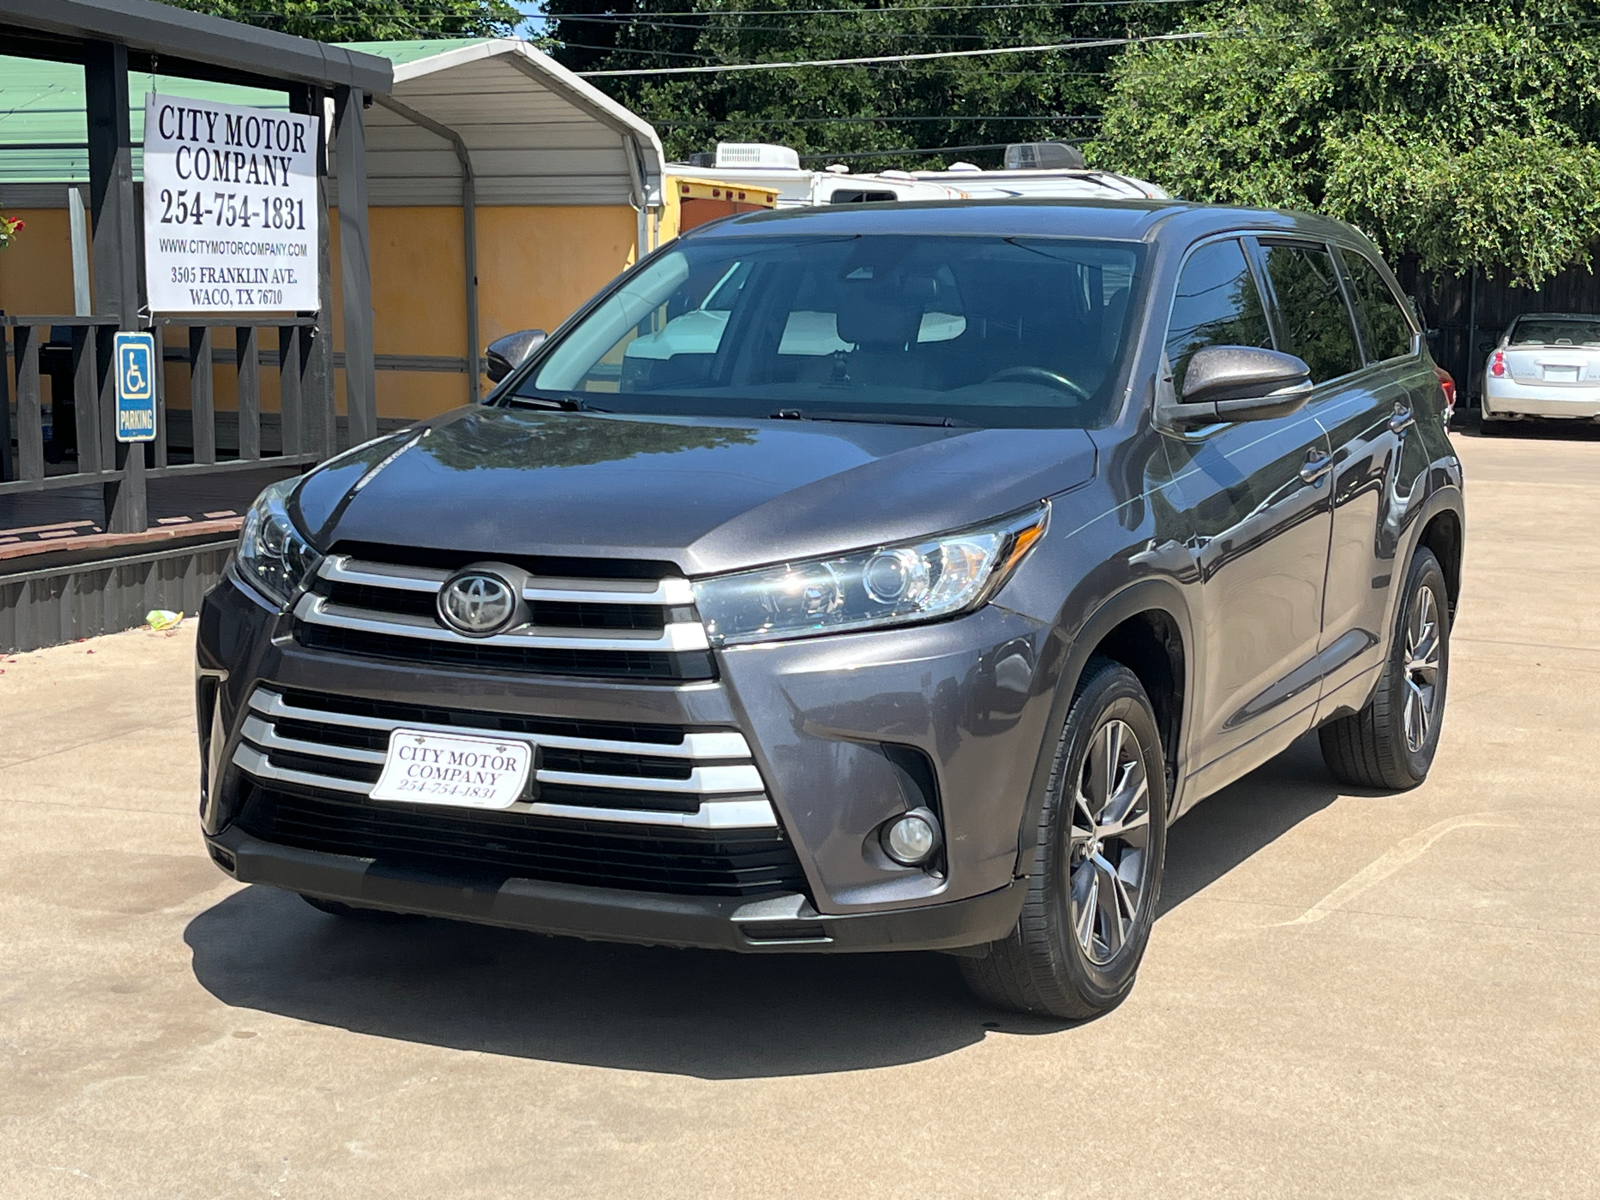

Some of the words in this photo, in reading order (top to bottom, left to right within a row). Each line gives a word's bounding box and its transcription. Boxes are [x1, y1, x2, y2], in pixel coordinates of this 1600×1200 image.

[159, 105, 219, 144] CITY
[225, 114, 306, 153] MOTOR
[176, 146, 292, 186] COMPANY
[161, 189, 306, 230] 254-754-1831
[159, 238, 308, 257] WWW.CITYMOTORCOMPANY.COM
[171, 266, 196, 283] 3505
[199, 267, 269, 284] FRANKLIN
[271, 268, 298, 284] AVE.
[189, 288, 234, 308] WACO,
[236, 289, 255, 305] TX
[257, 289, 283, 305] 76710
[120, 410, 152, 430] PARKING
[399, 745, 443, 763] CITY
[449, 751, 517, 772] MOTOR
[407, 764, 502, 786] COMPANY
[397, 780, 497, 799] 254-754-1831
